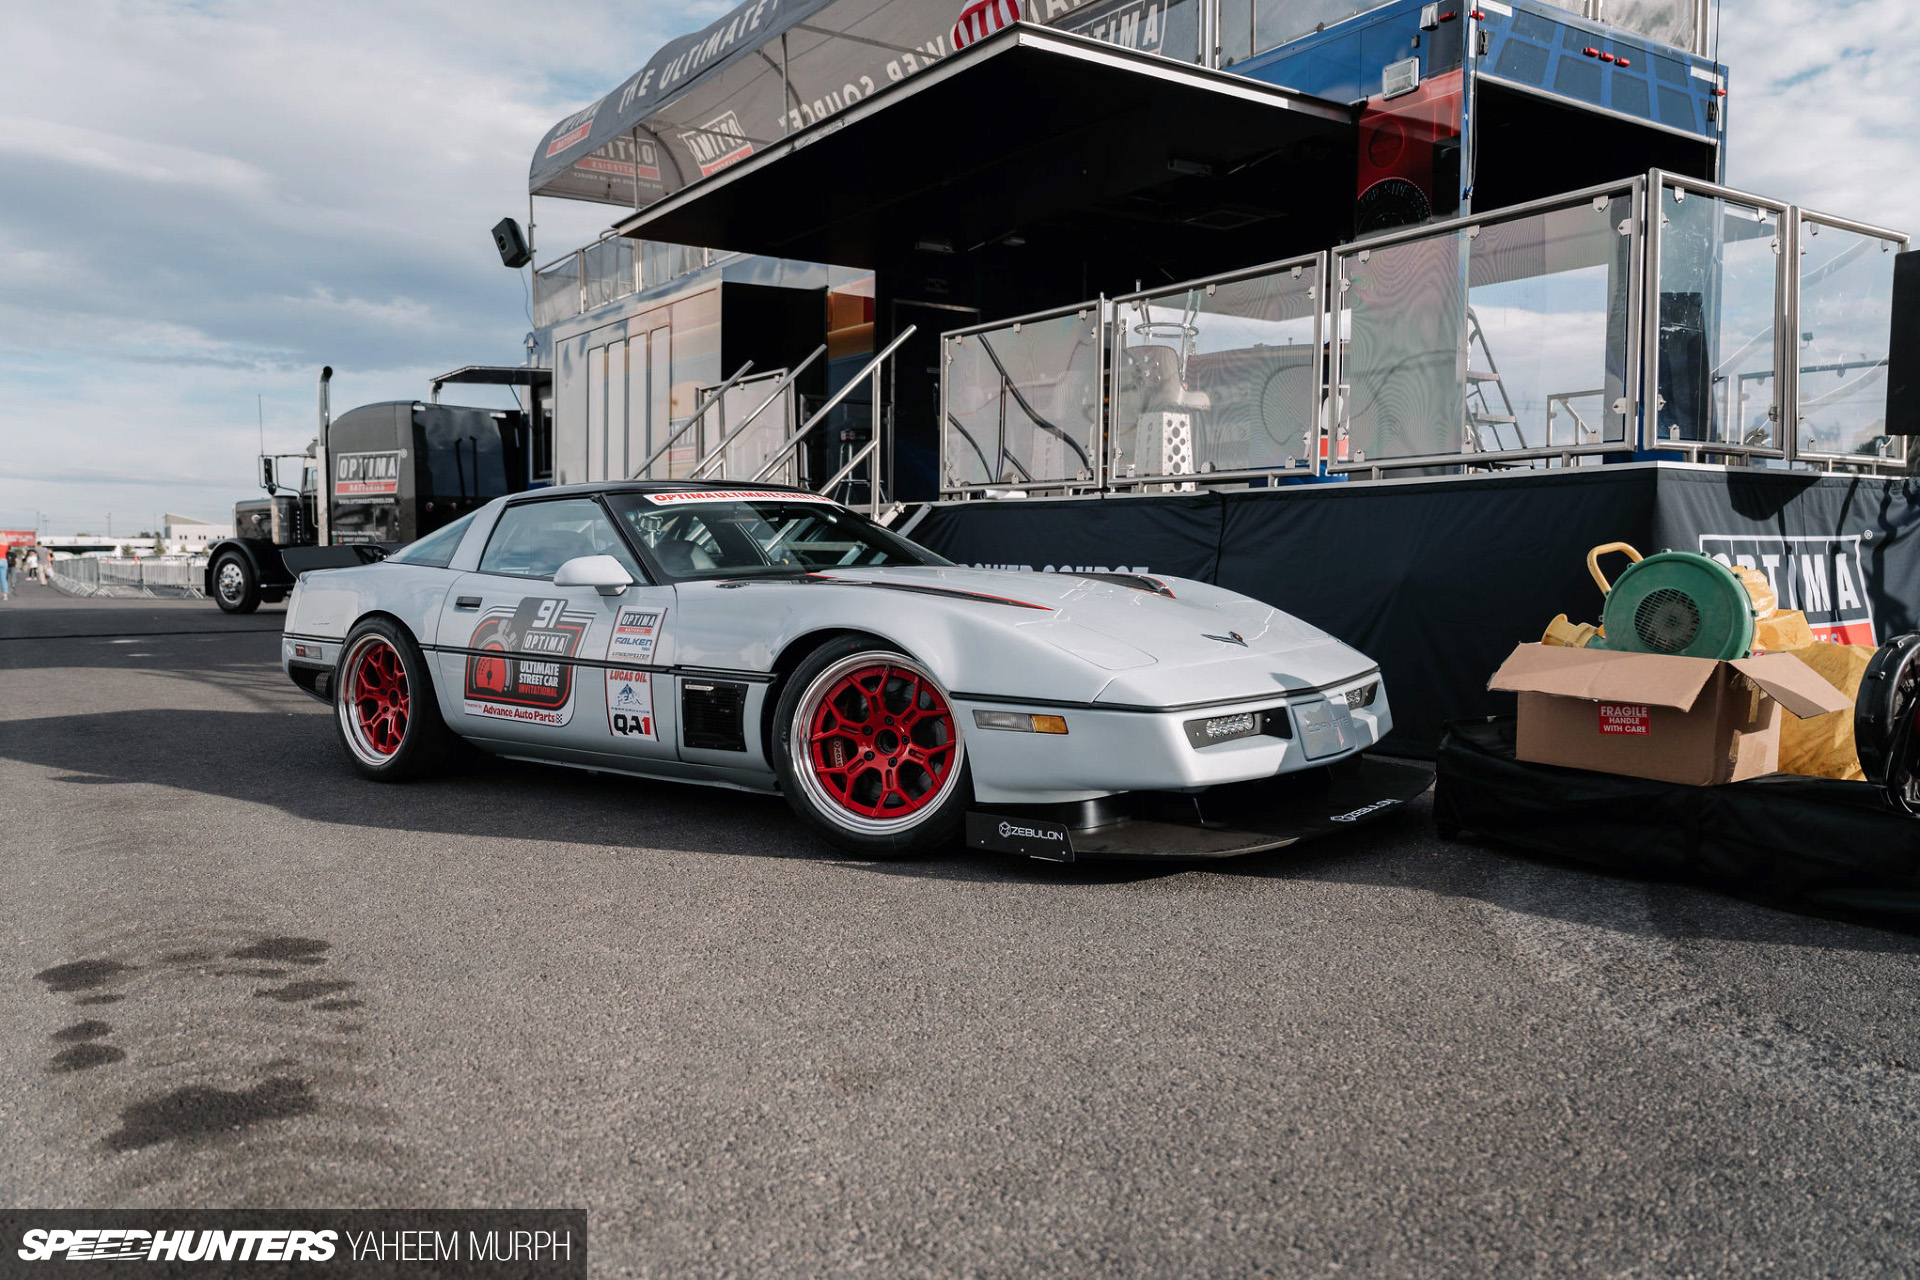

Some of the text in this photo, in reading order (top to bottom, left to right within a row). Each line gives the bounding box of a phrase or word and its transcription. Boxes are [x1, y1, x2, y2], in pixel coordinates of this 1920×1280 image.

[1082, 3, 1158, 50] TIMA
[618, 0, 768, 114] THE ULTIMATE
[339, 457, 396, 479] OPTIMA
[1712, 552, 1862, 613] TIMA
[531, 600, 566, 628] 91
[622, 613, 656, 627] OPTIMA
[524, 634, 565, 652] OPTIMA
[614, 636, 653, 647] FALKEN
[520, 660, 560, 676] ULTIMATE
[519, 673, 559, 687] STREET CAR
[609, 670, 647, 683] LUCAS OIL
[518, 683, 558, 697] INVITATIONAL
[483, 704, 556, 723] Advance Auto Parts
[1600, 706, 1648, 717] FRAGILE
[613, 713, 652, 736] QA1
[1603, 724, 1647, 733] WITH CARE
[1608, 717, 1640, 725] HANDLE
[1010, 826, 1064, 841] ZEBULON
